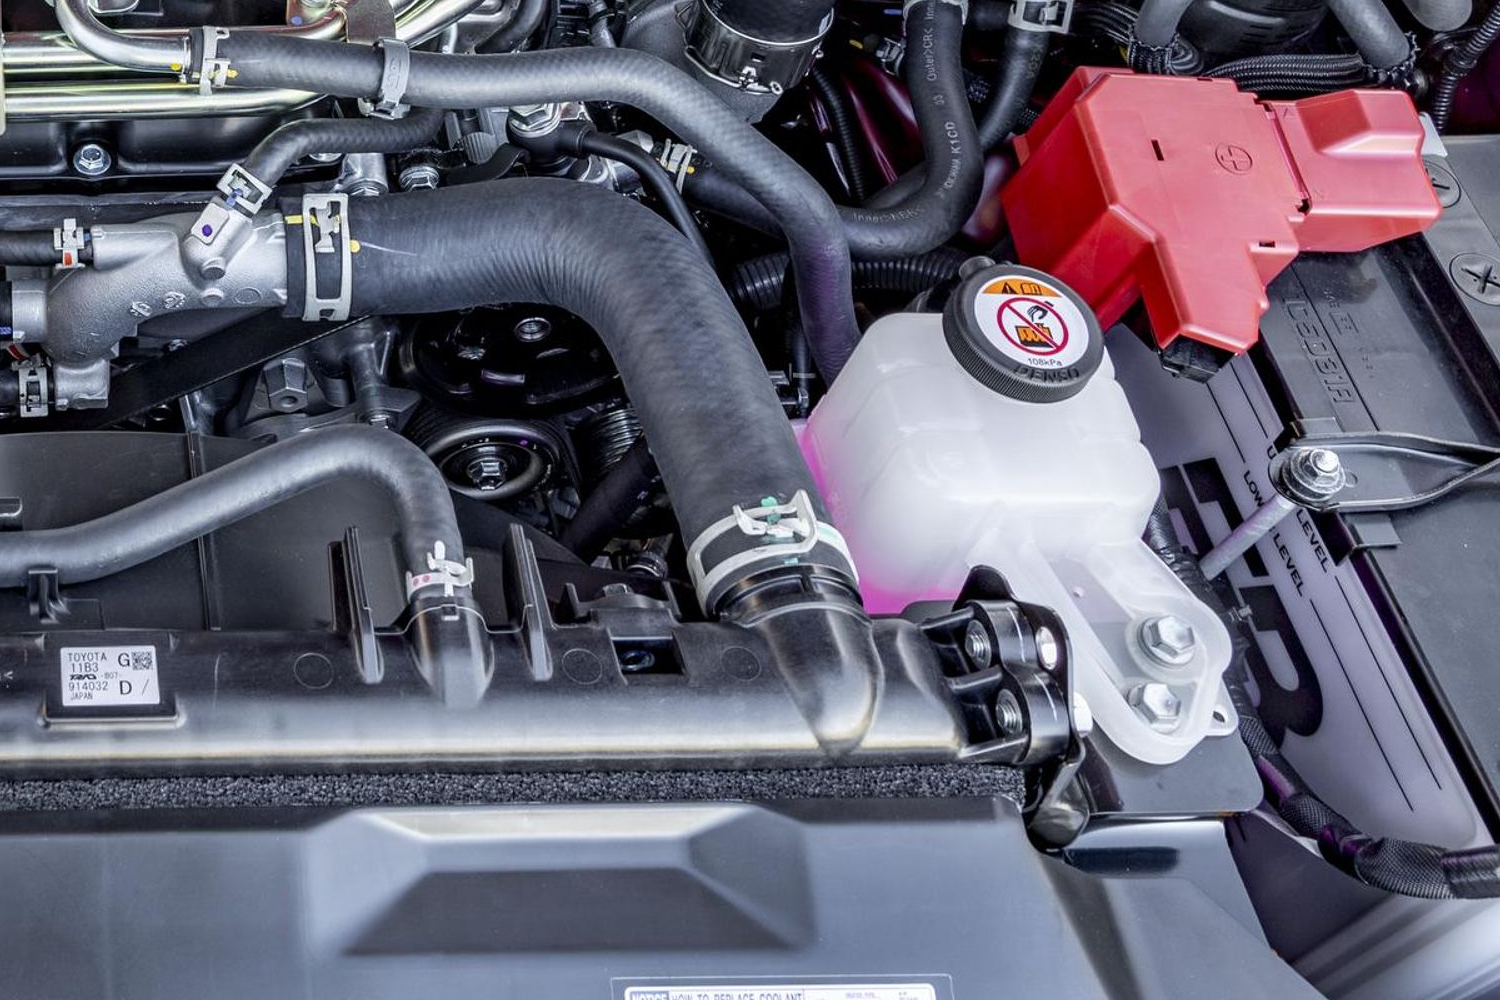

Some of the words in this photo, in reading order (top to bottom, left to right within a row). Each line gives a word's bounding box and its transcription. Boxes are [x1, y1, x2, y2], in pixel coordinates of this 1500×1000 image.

[944, 121, 962, 155] K1CD
[1027, 357, 1063, 367] 108kPa
[1296, 510, 1329, 573] LEVEL
[1274, 529, 1305, 597] LEVEL
[67, 652, 108, 662] TOYOTA
[117, 652, 130, 668] G
[70, 662, 100, 673] 11B3
[68, 681, 109, 692] 914032
[119, 680, 132, 695] D
[70, 692, 94, 700] JAPAN
